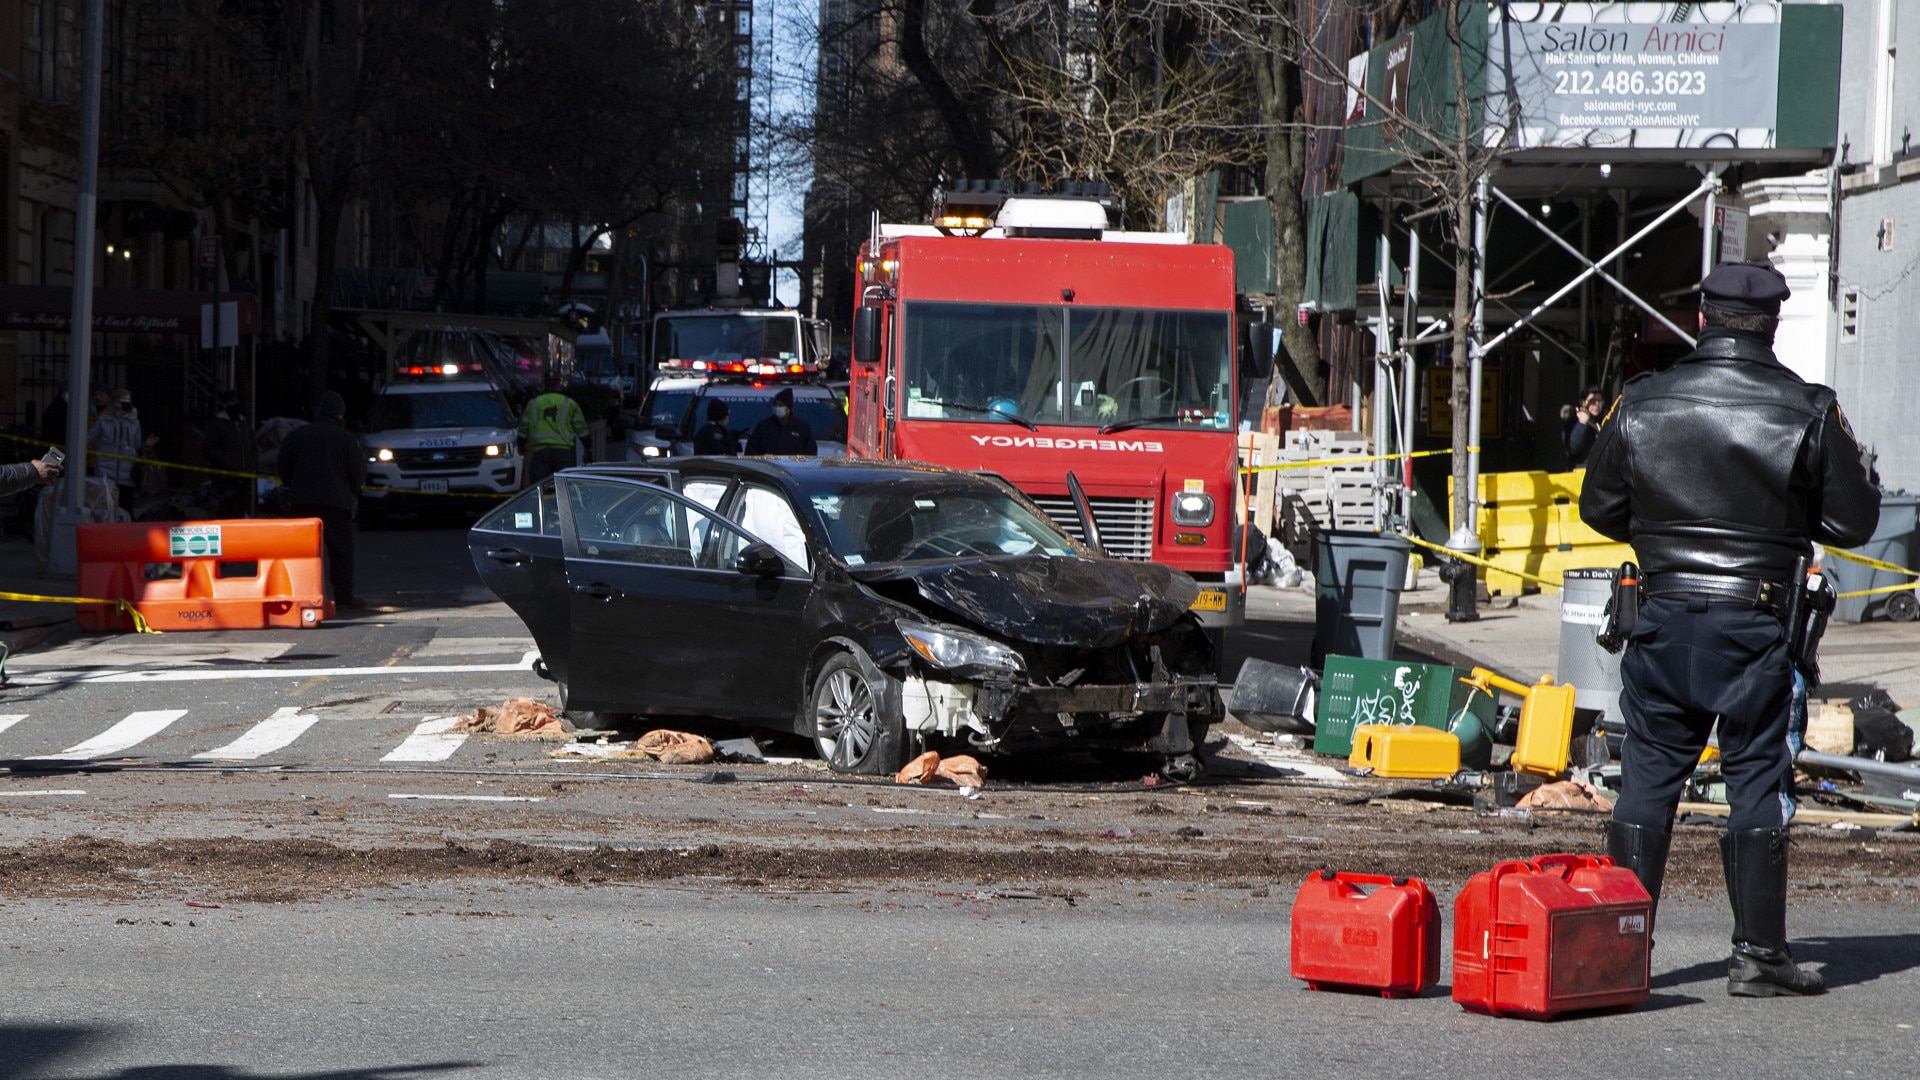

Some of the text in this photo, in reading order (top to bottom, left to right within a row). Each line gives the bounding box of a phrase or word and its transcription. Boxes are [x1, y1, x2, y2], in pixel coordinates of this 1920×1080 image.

[1643, 25, 1727, 52] Amici
[1545, 53, 1719, 66] Hair Salon for Men, Women, Children
[1554, 70, 1706, 95] 212.486.3623
[1583, 100, 1677, 112] salonamici-nyc.com
[1560, 114, 1700, 126] facebook.com/SalonAmiciNYC
[418, 439, 459, 447] POLICE
[172, 535, 219, 555] DOT
